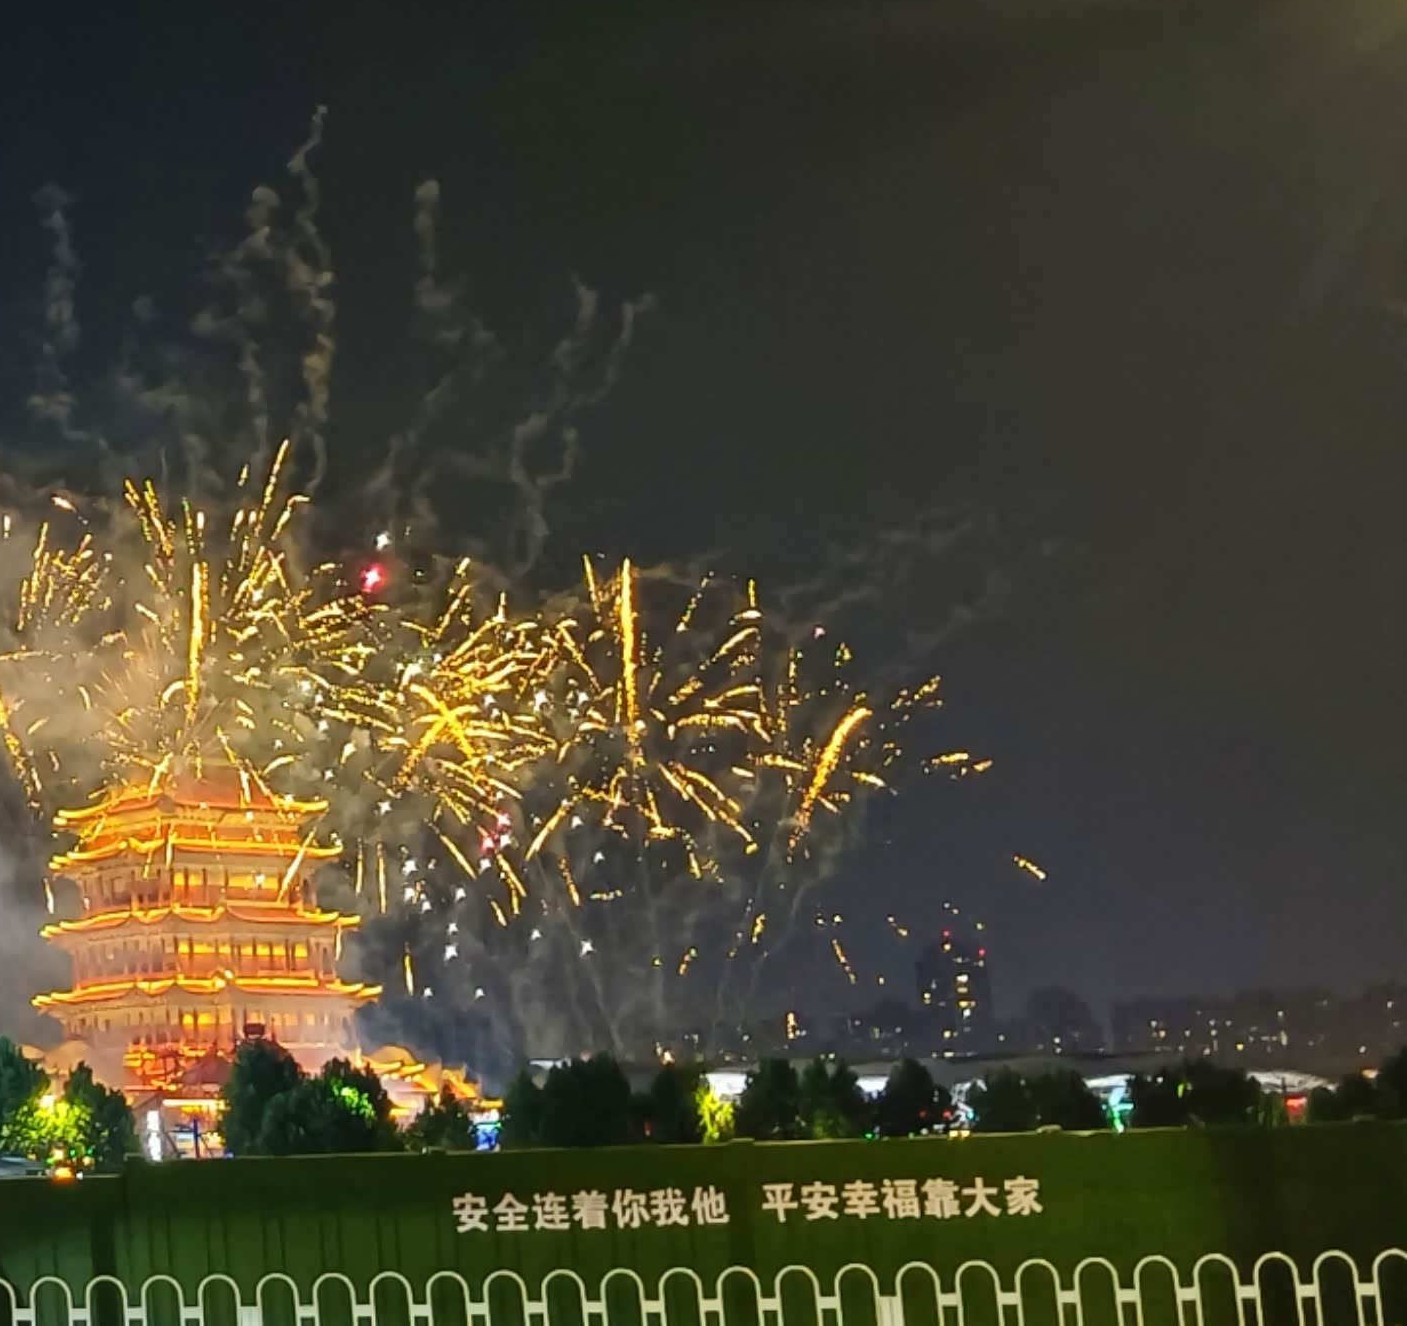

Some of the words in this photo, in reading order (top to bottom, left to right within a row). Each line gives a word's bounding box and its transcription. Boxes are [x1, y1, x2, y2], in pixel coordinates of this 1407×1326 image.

[452, 1185, 730, 1232] 安全连着你我他
[761, 1175, 1044, 1223] 平安幸福靠大家
